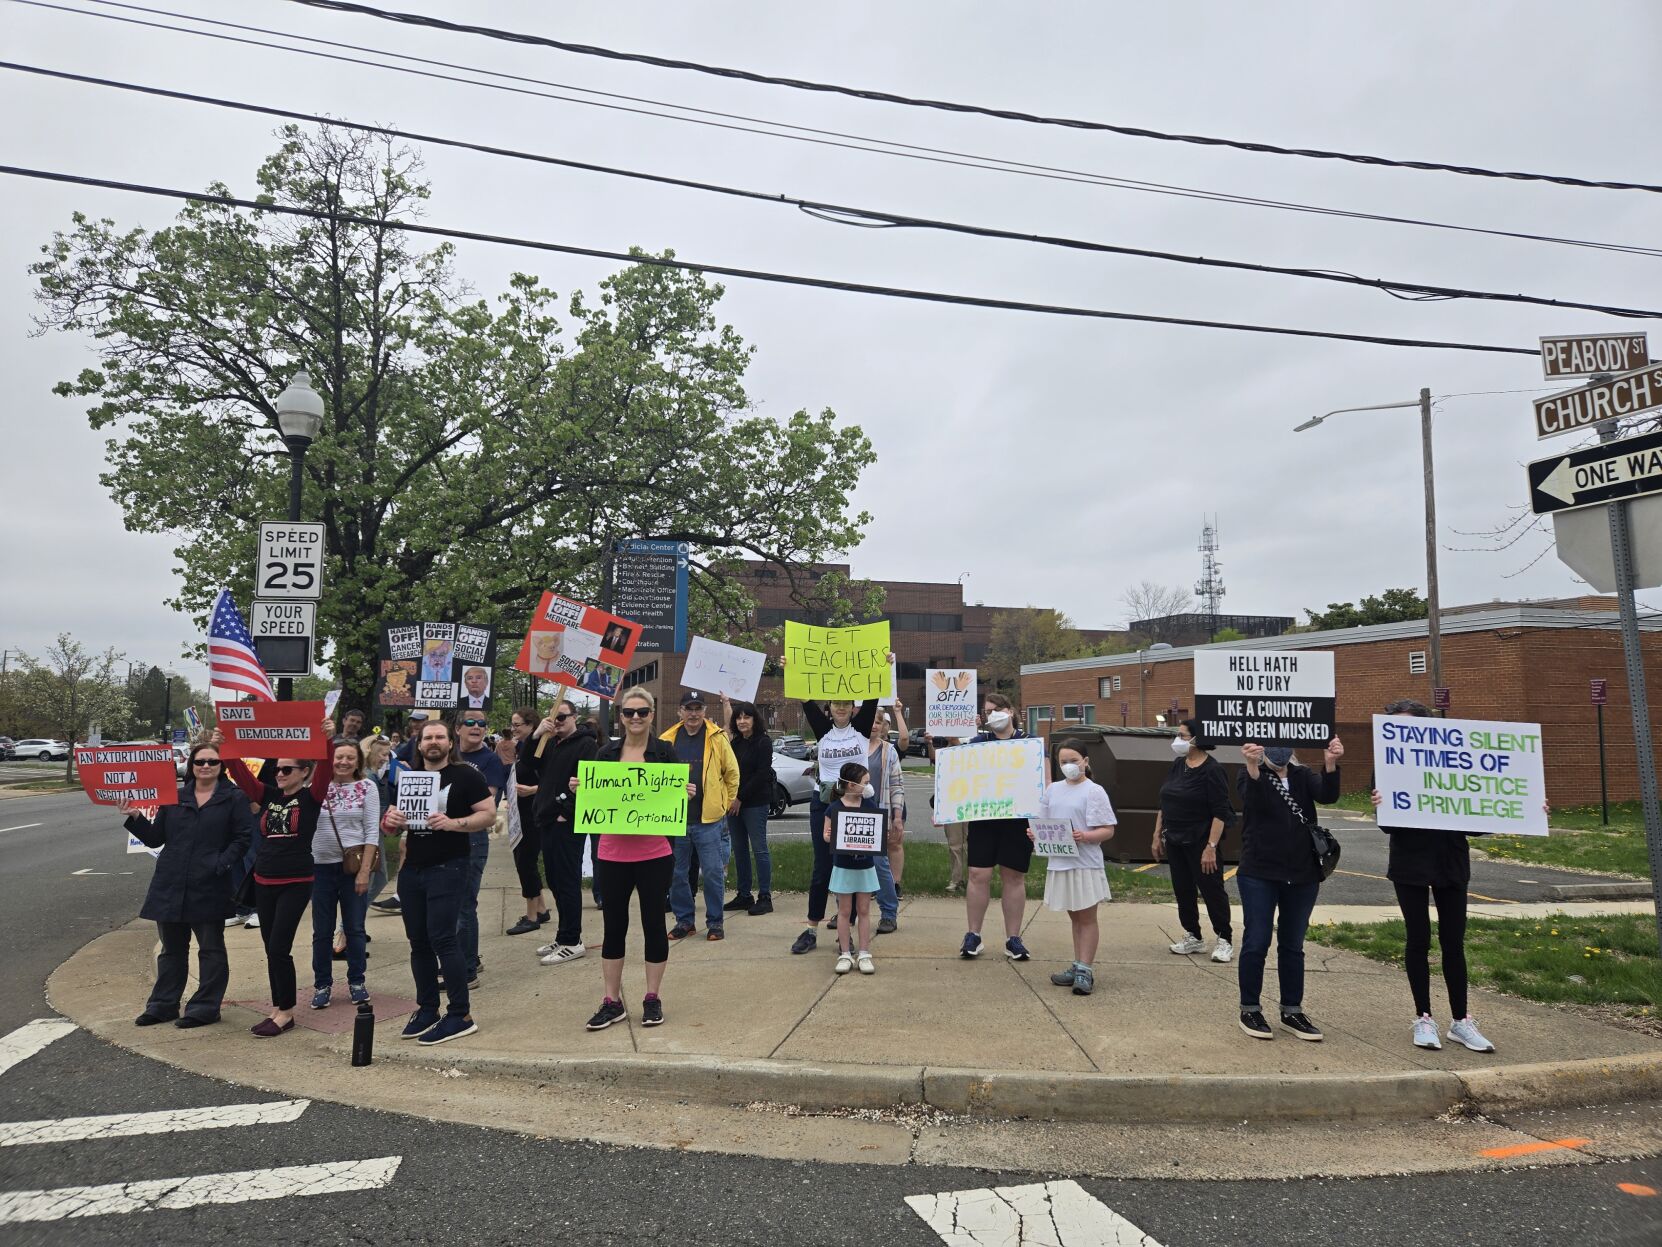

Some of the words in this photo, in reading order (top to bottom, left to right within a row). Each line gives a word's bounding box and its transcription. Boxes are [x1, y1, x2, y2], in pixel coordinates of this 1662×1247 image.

[1544, 339, 1630, 374] PEABODY
[1632, 338, 1645, 354] ST
[1541, 374, 1652, 433] CHURCH
[1653, 370, 1662, 388] S
[1575, 461, 1619, 488] ONE
[1627, 449, 1662, 478] WA
[265, 531, 319, 543] SPEED
[269, 547, 312, 559] LIMIT
[651, 543, 675, 551] Center
[264, 562, 315, 590] 25
[556, 598, 582, 612] HANDS
[265, 606, 303, 619] YOUR
[552, 604, 580, 620] OFF!
[545, 612, 580, 630] MEDICARE
[260, 621, 305, 635] SPEED
[390, 626, 418, 636] HANDS
[460, 626, 488, 638] HANDS
[808, 627, 861, 645] LET
[391, 641, 421, 653] CANCER
[455, 644, 484, 656] SOCIAL
[391, 649, 423, 660] RESEARCH
[453, 651, 484, 663] SECURITY
[788, 646, 888, 669] TEACHERS
[555, 661, 582, 679] SECURITY
[559, 654, 585, 673] SOCIAL
[1229, 656, 1260, 672] HELL
[1264, 656, 1297, 672] HATH
[422, 682, 451, 690] HANDS
[800, 672, 883, 695] TEACH
[1237, 675, 1253, 691] NO
[1259, 675, 1291, 691] FURY
[430, 700, 458, 708] COURTS
[1217, 699, 1243, 716] LIKE
[1246, 701, 1255, 717] A
[1257, 701, 1312, 718] COUNTRY
[222, 708, 251, 720] SAVE
[929, 711, 942, 719] OUR
[945, 711, 974, 719] RIGHTS
[929, 719, 943, 727] OUR
[945, 719, 975, 727] FUTURE
[239, 728, 310, 740] DEMOCRACY.
[1201, 720, 1243, 738] THAT'S
[1245, 722, 1278, 739] BEEN
[1279, 722, 1329, 740] MUSKED
[1382, 722, 1464, 747] STAYING
[1469, 731, 1540, 753] SILENT
[79, 752, 94, 765] AN
[96, 749, 172, 765] EXTORTIONIST,
[949, 745, 1025, 773] HANDS
[1385, 746, 1405, 765] IN
[1410, 748, 1473, 770] TIMES
[1480, 753, 1510, 773] OF
[105, 772, 126, 784] NOT
[129, 772, 137, 783] A
[402, 777, 432, 785] HANDS
[584, 766, 633, 790] Human
[628, 767, 685, 792] Rights
[1423, 771, 1529, 796] INJUSTICE
[401, 784, 432, 796] OFF!
[948, 773, 1022, 802] OFF
[96, 788, 157, 801] NEGOTIATOR
[621, 792, 646, 802] are
[399, 799, 430, 811] CIVIL
[956, 797, 1014, 820] SCIENCE
[1392, 791, 1412, 810] IS
[1417, 793, 1525, 819] PRIVILEGE
[403, 811, 429, 821] GHTS
[582, 808, 618, 824] NOT
[626, 798, 685, 828] Optional!
[846, 817, 875, 825] HANDS
[1036, 824, 1066, 832] HANDS
[844, 836, 875, 846] LIBRARIES
[1038, 831, 1065, 841] OFF
[1038, 843, 1075, 856] SCIENCE
